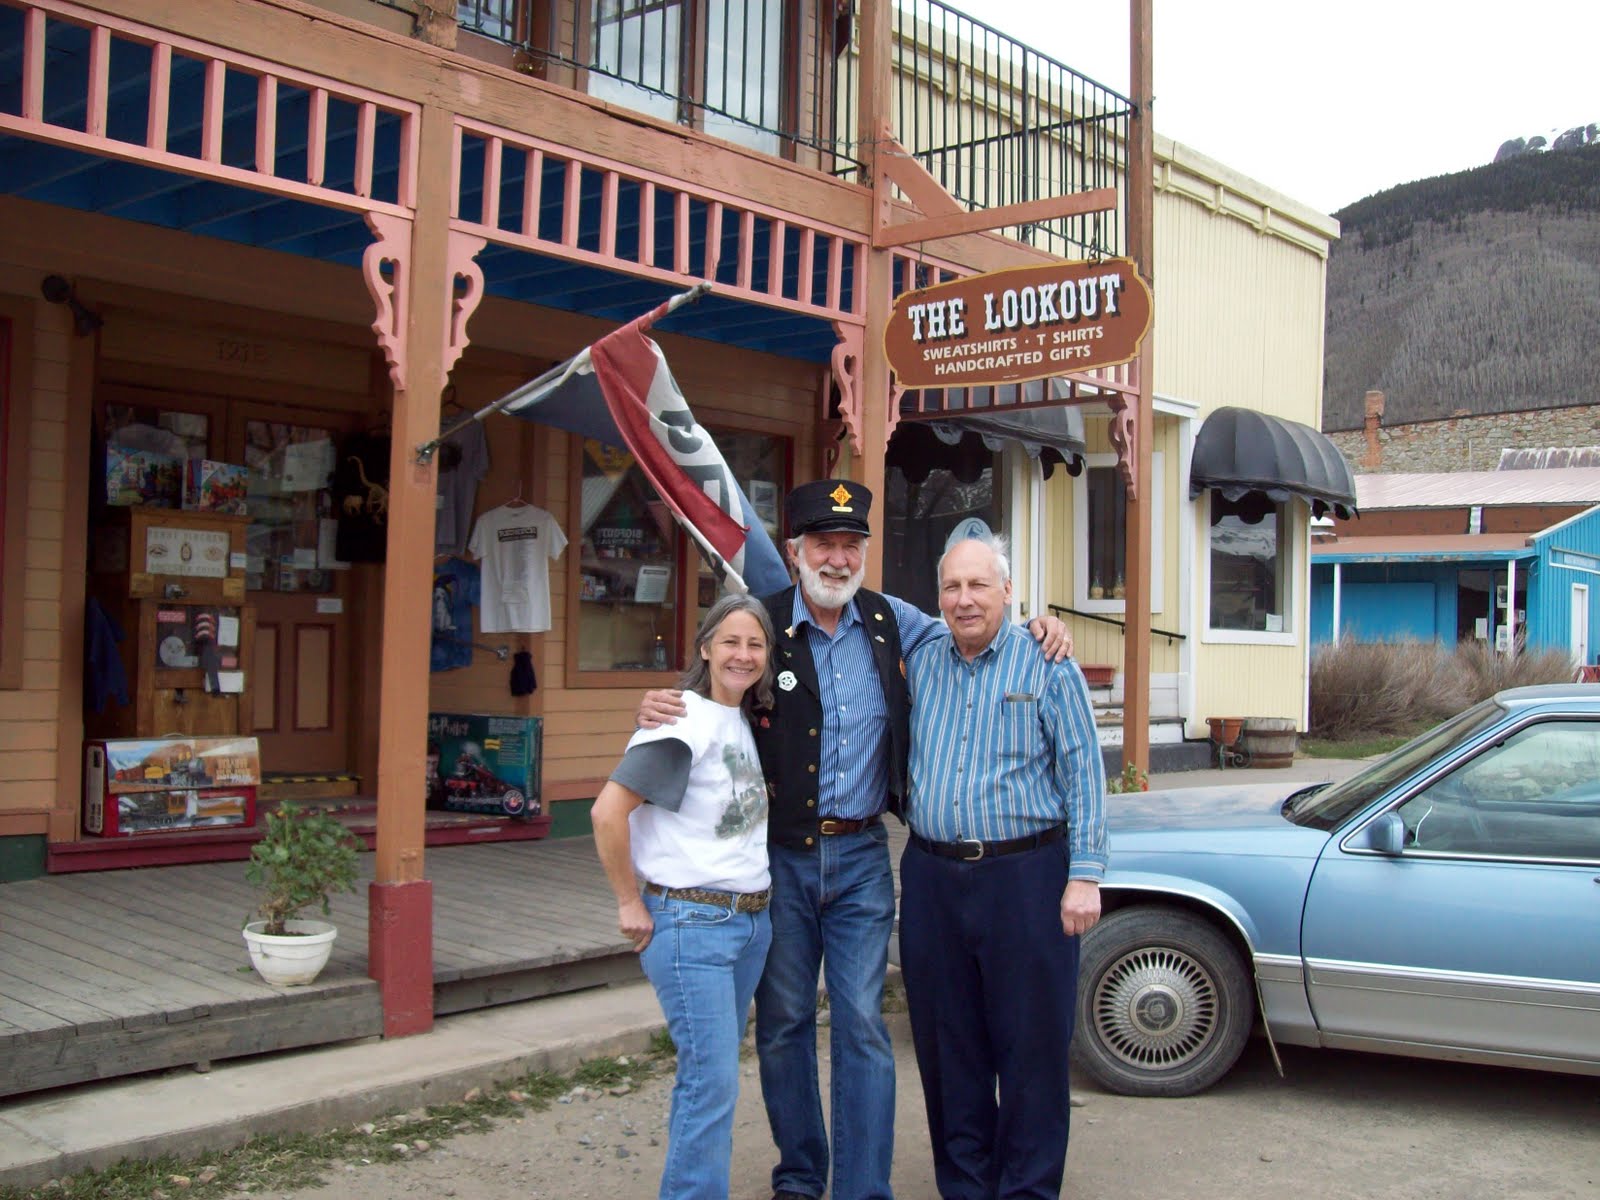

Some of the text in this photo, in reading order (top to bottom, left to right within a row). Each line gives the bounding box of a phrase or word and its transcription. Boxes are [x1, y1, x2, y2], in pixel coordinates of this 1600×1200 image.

[908, 274, 1122, 342] THE LOOKOUT
[923, 326, 1104, 361] SWEATSHIRTS T SHIRTS
[935, 345, 1091, 375] HANDCRAFTED GIFTS
